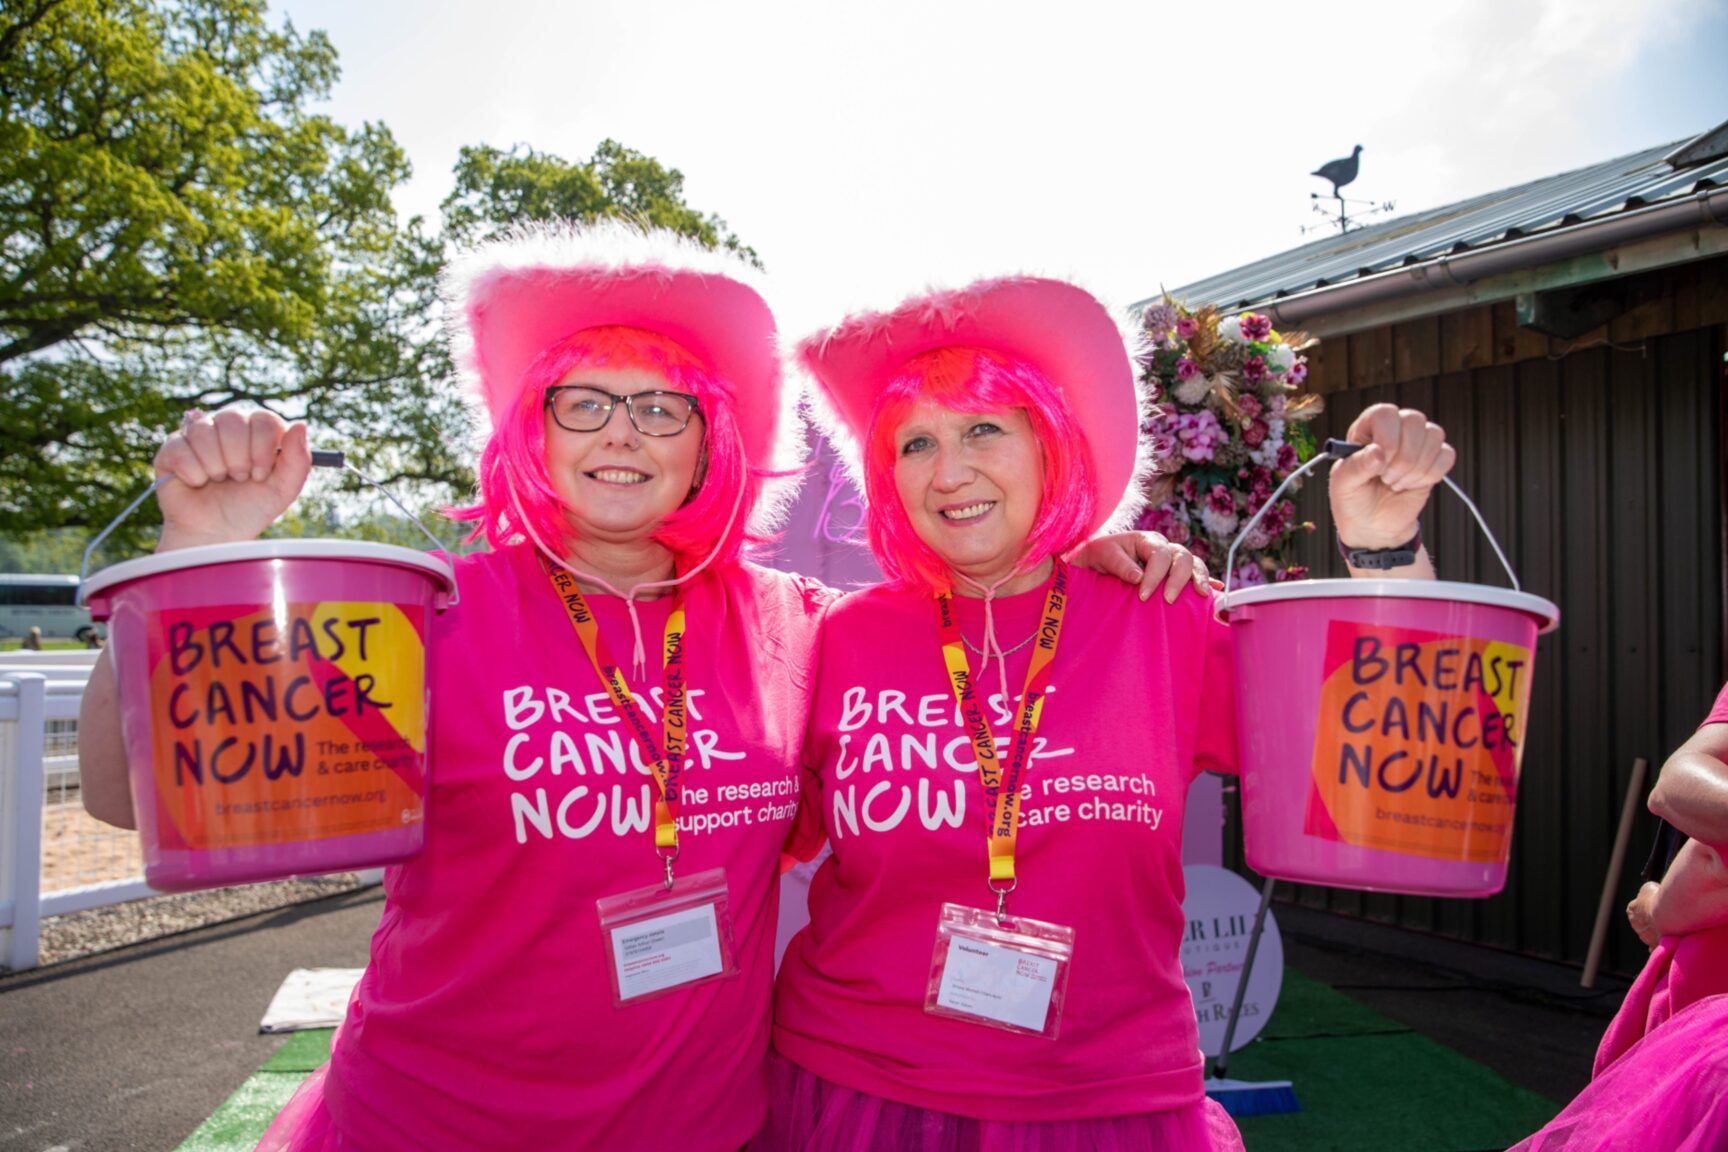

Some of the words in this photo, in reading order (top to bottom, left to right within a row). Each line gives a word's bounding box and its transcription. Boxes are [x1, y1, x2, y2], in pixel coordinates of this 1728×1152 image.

[563, 593, 591, 623] NOW
[1039, 616, 1059, 650] NOW
[169, 617, 381, 676] BREAST
[666, 632, 682, 664] NOW
[1351, 635, 1525, 700] BREAST
[168, 673, 393, 729] CANCER
[667, 668, 684, 728] CANCER
[952, 670, 976, 700] NOW
[317, 740, 349, 755] The
[966, 703, 994, 760] CANCER
[1341, 690, 1518, 752] CANCER
[174, 732, 305, 787] NOW
[317, 761, 329, 775] &
[334, 760, 370, 774] care
[665, 731, 683, 802] BREAST
[997, 691, 1041, 837] breastcancernow.org
[1338, 742, 1464, 799] NOW
[215, 789, 386, 816] breastcancernow.org
[510, 784, 651, 844] NOW
[682, 784, 709, 806] he
[717, 774, 793, 802] research
[674, 806, 753, 836] support
[833, 778, 966, 840] NOW
[1042, 772, 1156, 797] research
[1016, 801, 1072, 828] care
[1077, 796, 1163, 831] charity
[958, 944, 989, 957] Volunteer
